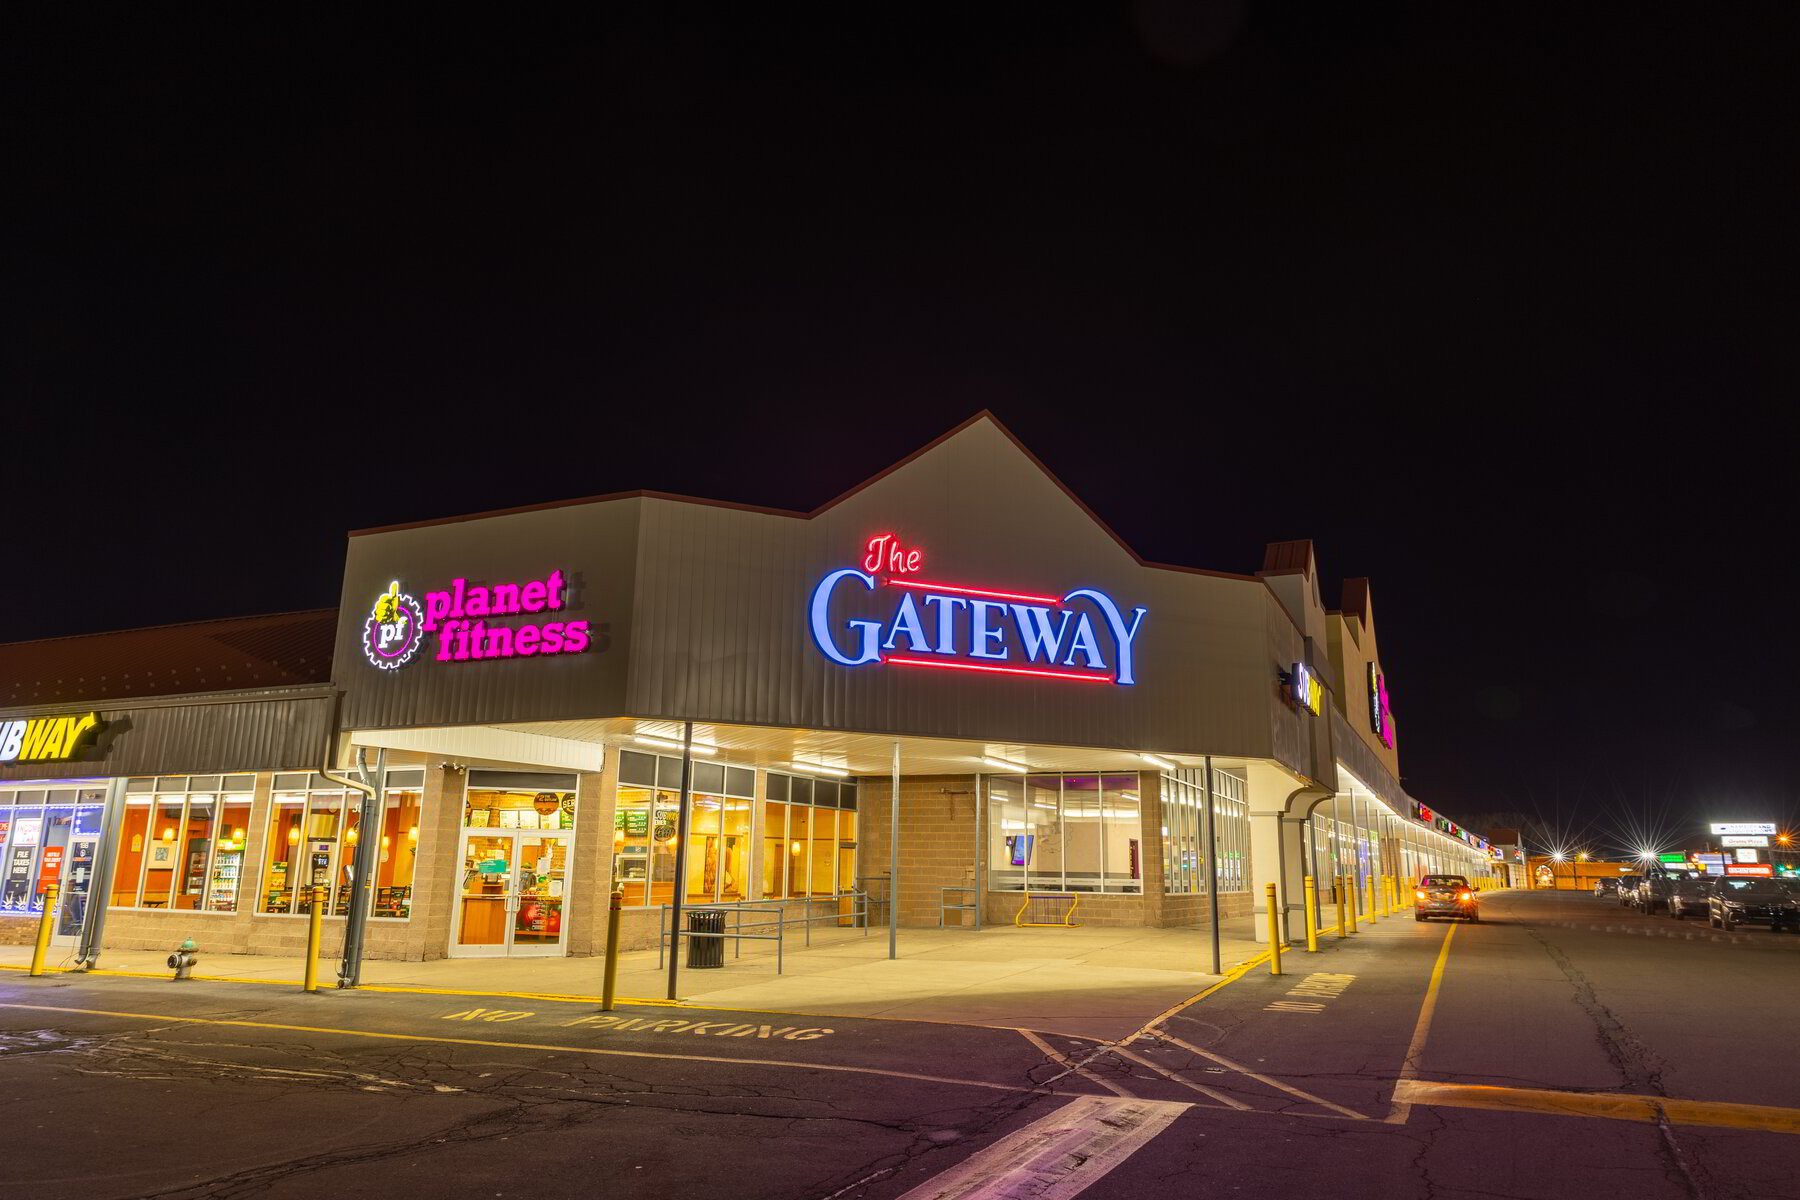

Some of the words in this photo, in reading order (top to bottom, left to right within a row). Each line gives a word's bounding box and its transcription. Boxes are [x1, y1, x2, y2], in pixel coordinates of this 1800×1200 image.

[864, 534, 922, 573] The
[423, 569, 565, 632] planet
[378, 616, 409, 649] pf
[436, 619, 591, 662] fitness
[811, 567, 1147, 685] GATEWAY
[12, 866, 28, 874] HERE
[441, 1008, 535, 1022] NO
[560, 1015, 835, 1041] PARKING
